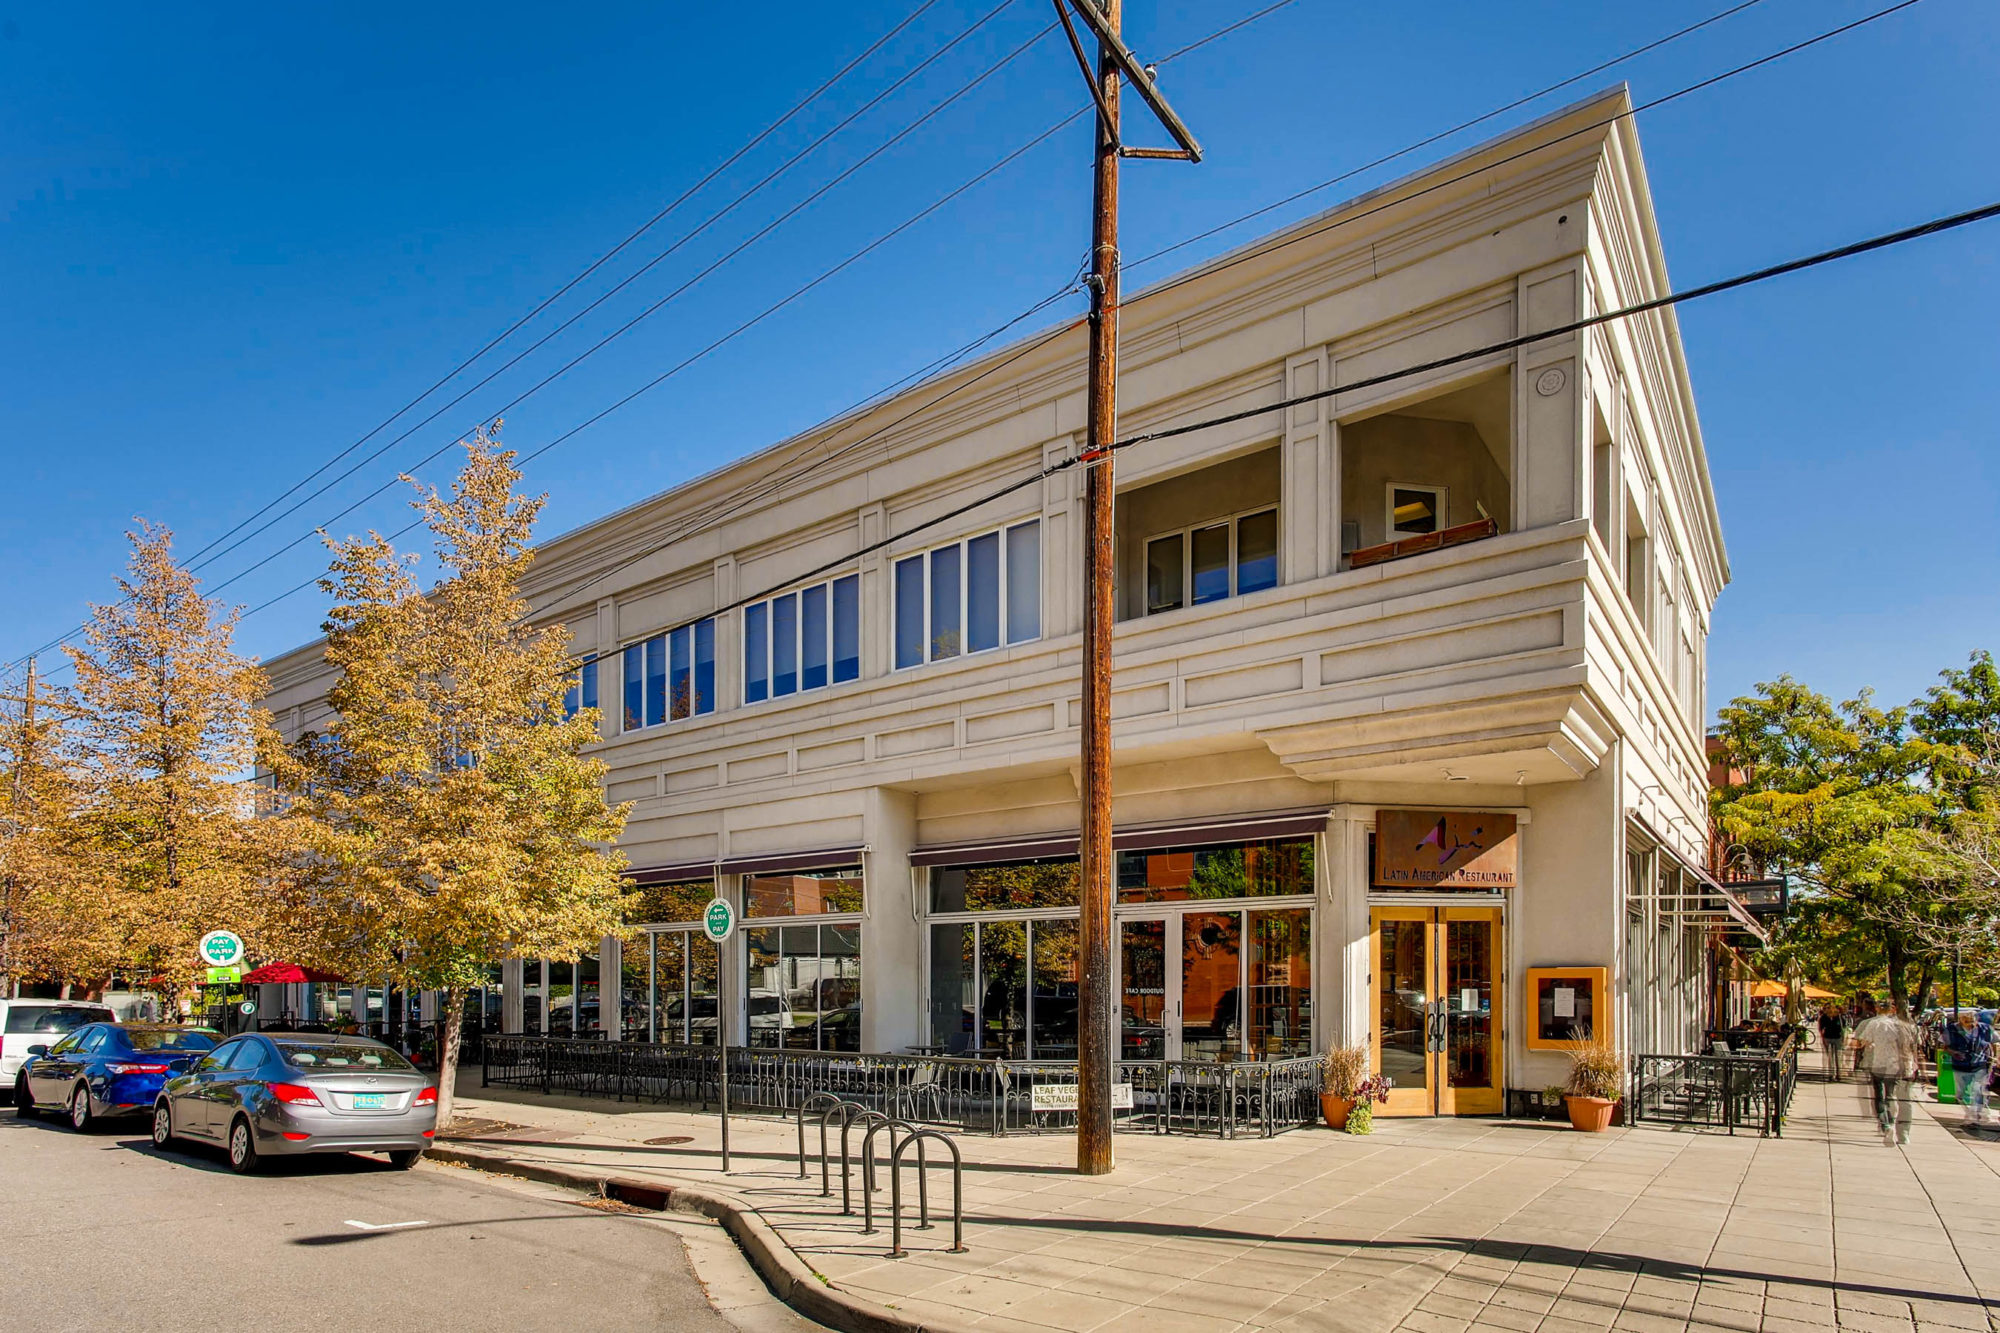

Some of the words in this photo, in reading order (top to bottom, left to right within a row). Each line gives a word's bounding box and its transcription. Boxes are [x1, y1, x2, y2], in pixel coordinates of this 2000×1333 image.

[1034, 1086, 1056, 1095] LEAF
[1057, 1086, 1079, 1094] VEGE
[1034, 1095, 1079, 1103] RESTAURA
